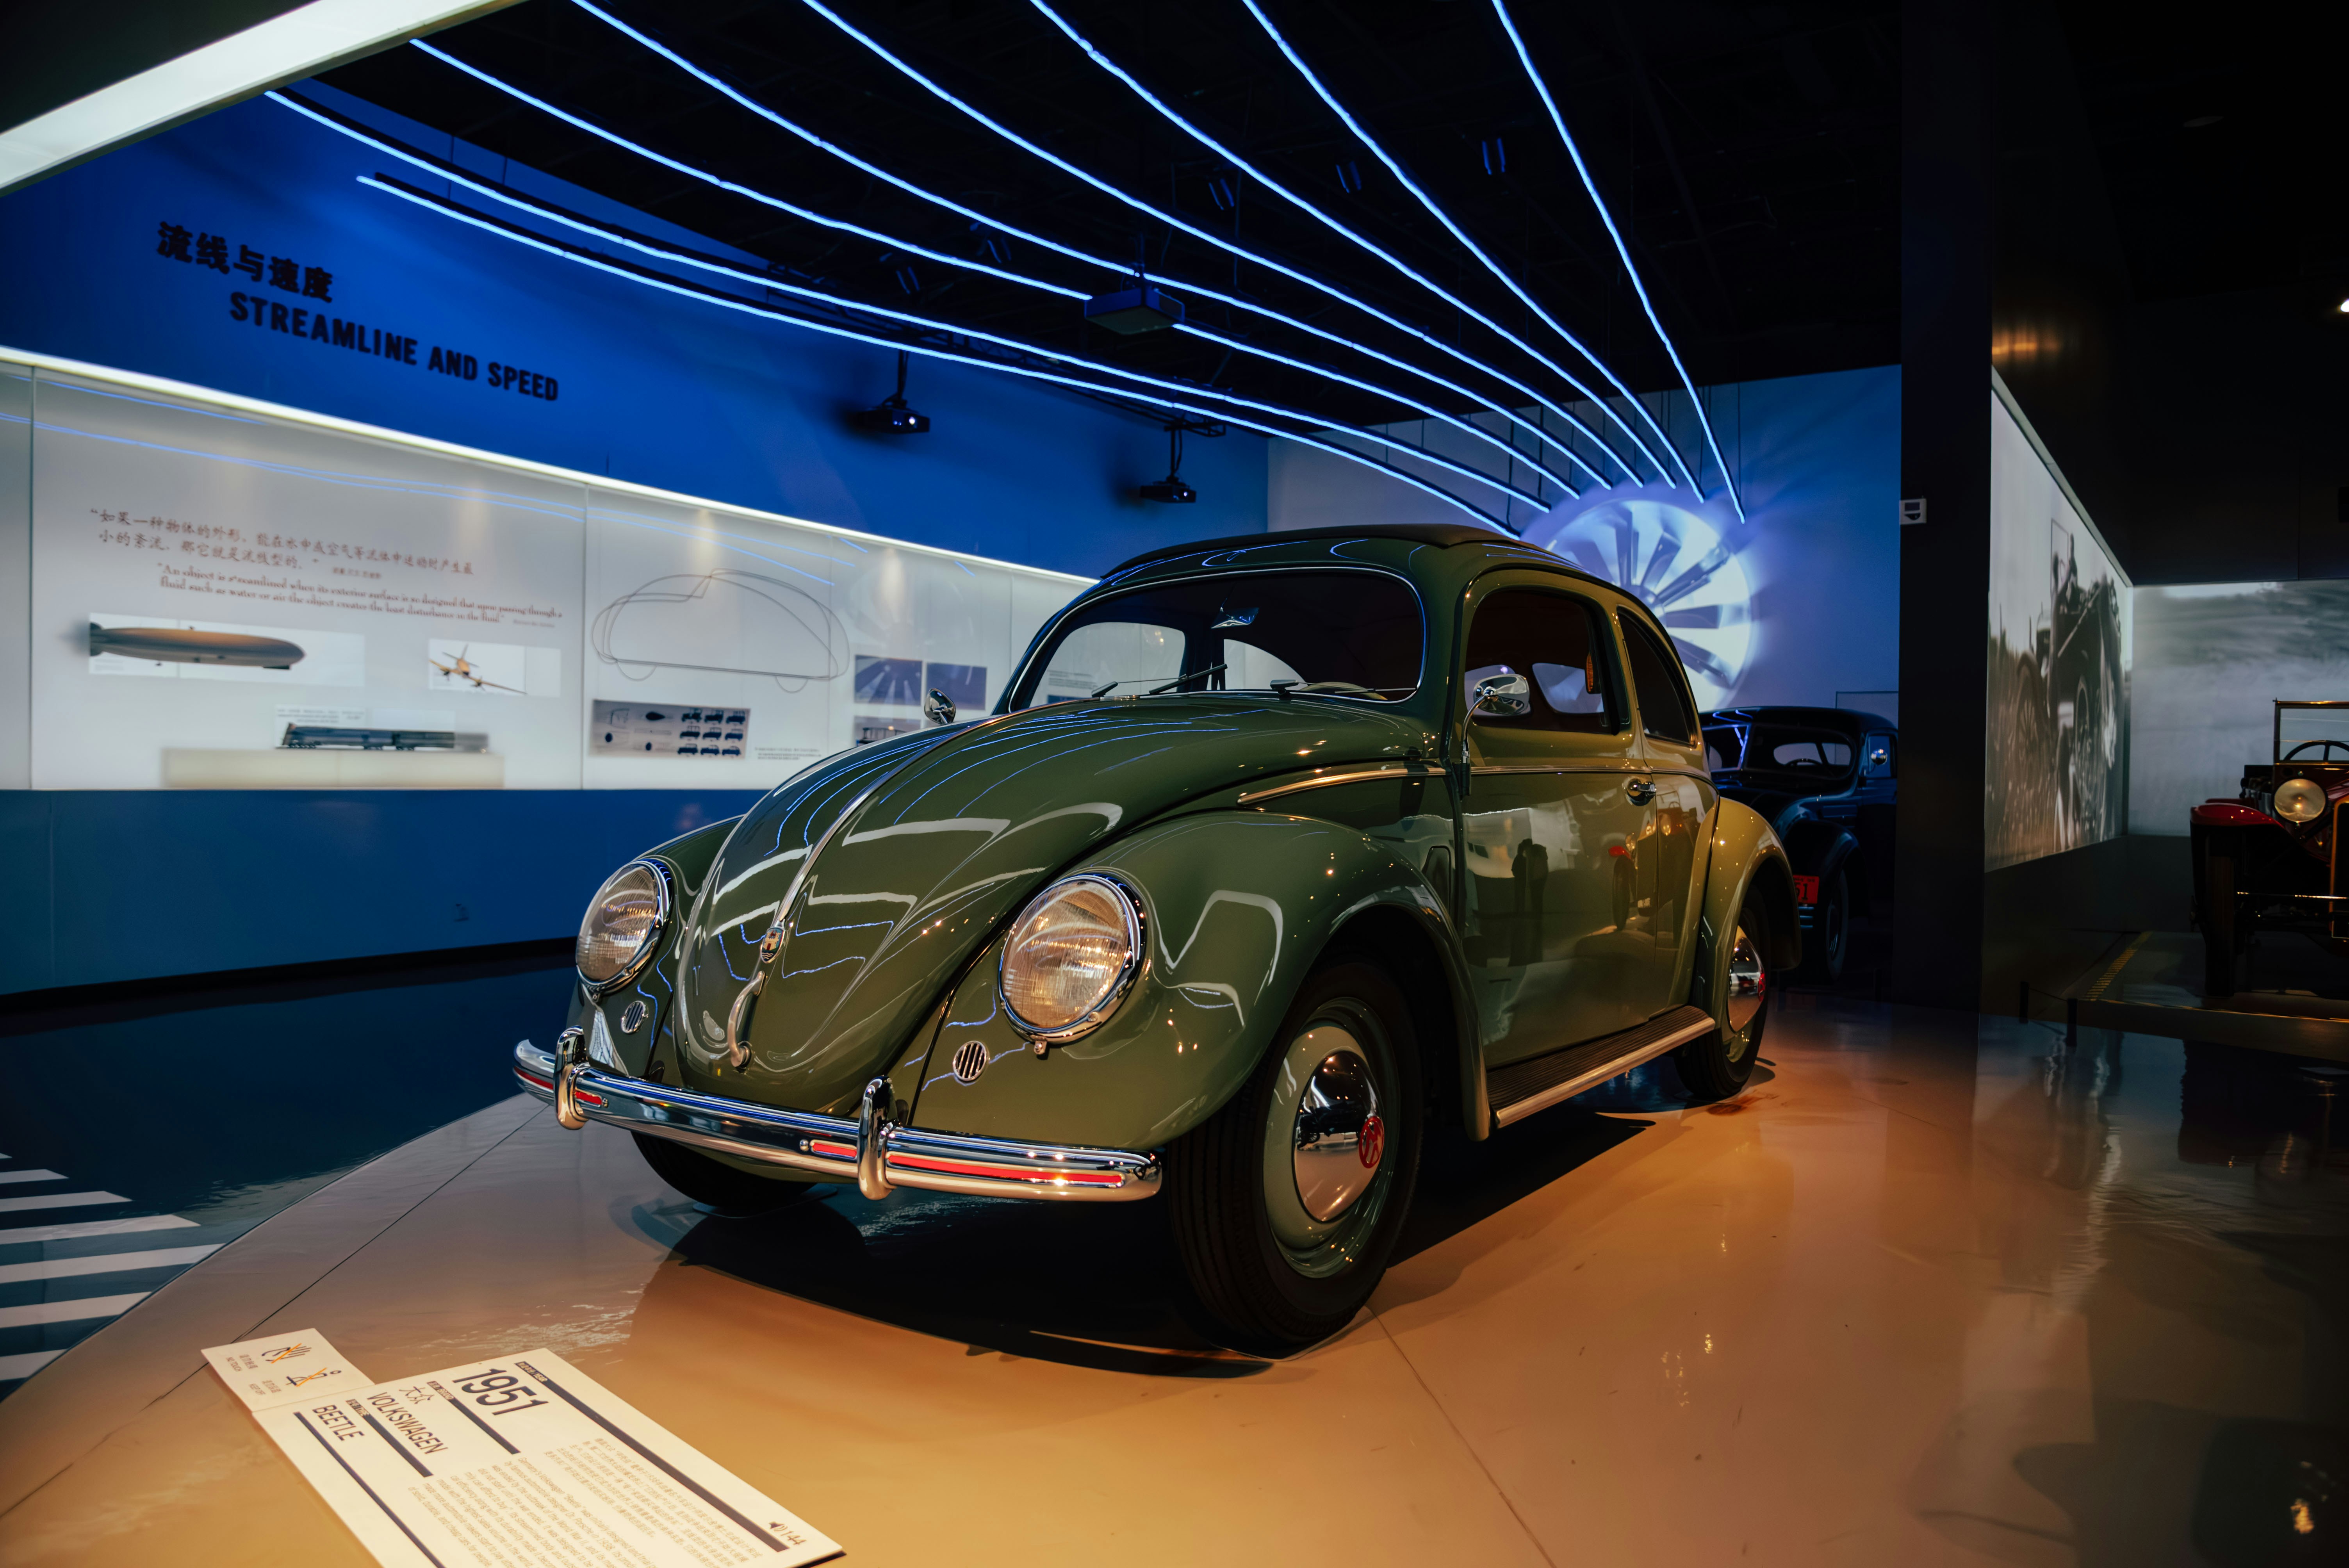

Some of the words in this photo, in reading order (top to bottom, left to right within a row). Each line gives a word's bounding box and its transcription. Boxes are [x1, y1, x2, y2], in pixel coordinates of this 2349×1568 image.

[157, 221, 333, 303] 流线与速度
[230, 292, 418, 365] STREAMLINE
[428, 346, 478, 381] AND
[487, 362, 558, 401] SPEED
[160, 576, 186, 590] fluid
[189, 581, 212, 593] such
[228, 588, 256, 599] water
[273, 593, 286, 602] air
[289, 592, 303, 604] the
[307, 595, 334, 607] object
[369, 601, 383, 612] the
[408, 606, 454, 620] disturbance
[467, 610, 479, 621] the
[182, 565, 214, 581] object
[218, 571, 225, 581] is
[228, 574, 287, 588] streamlined
[291, 579, 314, 592] when
[317, 584, 328, 593] its
[330, 588, 367, 598] exterior
[369, 589, 399, 601] surface
[403, 593, 409, 602] is
[422, 593, 457, 608] designed
[460, 598, 474, 608] that
[478, 603, 497, 612] upon
[499, 606, 526, 616] passing
[528, 605, 557, 618] through
[398, 1386, 434, 1404] 大众
[452, 1368, 549, 1415] 1951
[311, 1404, 366, 1441] BEETLE
[366, 1392, 449, 1455] VOLKSWAGEN
[515, 1457, 546, 1475] Germany's
[490, 1480, 506, 1489] start
[500, 1488, 517, 1498] until
[534, 1474, 569, 1495] Volkswagen
[410, 1490, 428, 1501] solid,
[508, 1465, 531, 1479] famous
[522, 1477, 553, 1498] automobile
[543, 1496, 571, 1513] designer
[570, 1517, 598, 1534] Porsche
[421, 1500, 443, 1517] durable,
[453, 1481, 481, 1499] efficiency
[472, 1497, 492, 1509] along
[484, 1507, 501, 1517] with
[498, 1521, 527, 1541] durability
[519, 1540, 539, 1552] made
[461, 1471, 478, 1480] mily
[478, 1486, 498, 1498] afford
[513, 1517, 546, 1541] streamlined
[537, 1540, 558, 1552] body
[550, 1550, 567, 1559] and
[497, 1471, 516, 1482] ended
[523, 1493, 549, 1509] outbreak
[555, 1520, 576, 1532] World
[568, 1531, 585, 1541] War
[584, 1545, 601, 1554] and
[578, 1509, 595, 1518] was
[421, 1482, 438, 1493] made
[431, 1493, 447, 1503] more
[441, 1502, 470, 1523] automobile
[463, 1522, 485, 1538] makers
[477, 1536, 494, 1547] start
[490, 1551, 506, 1560] pay
[435, 1479, 453, 1490] model
[447, 1490, 462, 1499] with
[460, 1504, 484, 1519] highest
[476, 1518, 494, 1529] sales
[487, 1528, 510, 1543] volume
[508, 1547, 522, 1555] the
[515, 1554, 536, 1568] world.
[437, 1516, 451, 1525] and
[525, 1511, 548, 1525] ended.
[586, 1516, 613, 1532] initially
[442, 1523, 463, 1538] cheap
[545, 1529, 561, 1538] was
[602, 1530, 635, 1549] designed
[782, 1530, 807, 1545] 144
[457, 1536, 472, 1546] cars
[552, 1536, 584, 1556] designed
[626, 1547, 644, 1557] and
[636, 1555, 656, 1566] trial
